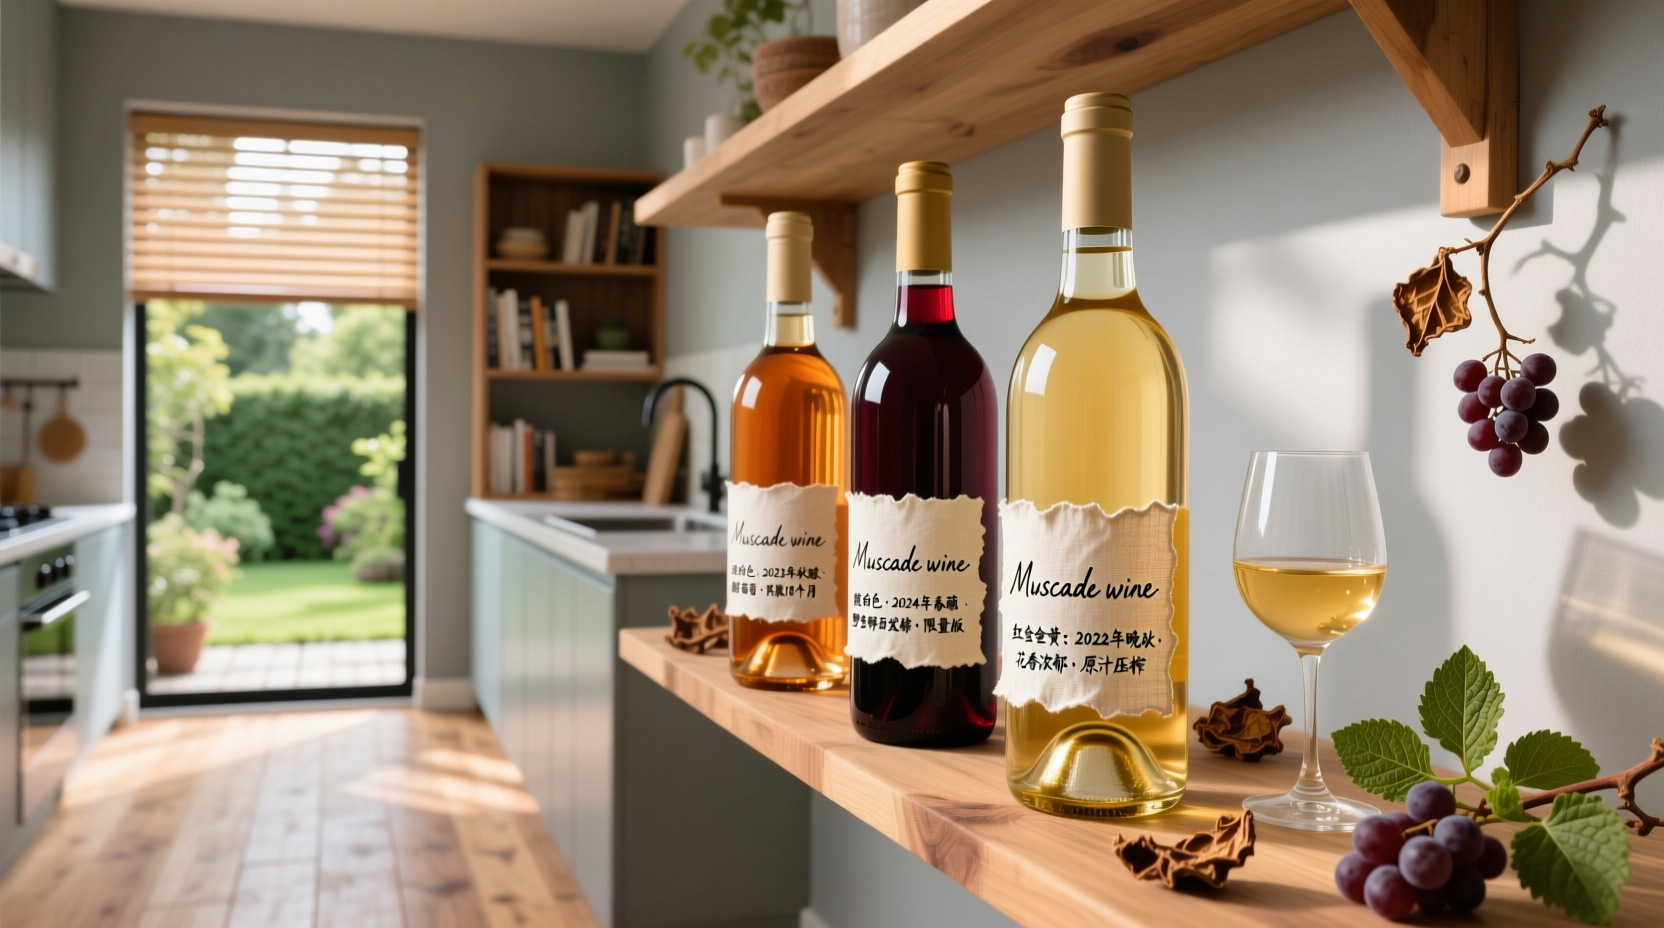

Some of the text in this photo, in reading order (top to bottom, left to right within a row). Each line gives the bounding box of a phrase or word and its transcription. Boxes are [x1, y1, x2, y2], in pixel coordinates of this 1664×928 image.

[731, 520, 826, 547] Muscade wine
[852, 540, 971, 573] Muscade wine
[1009, 560, 1160, 600] Muscade wine
